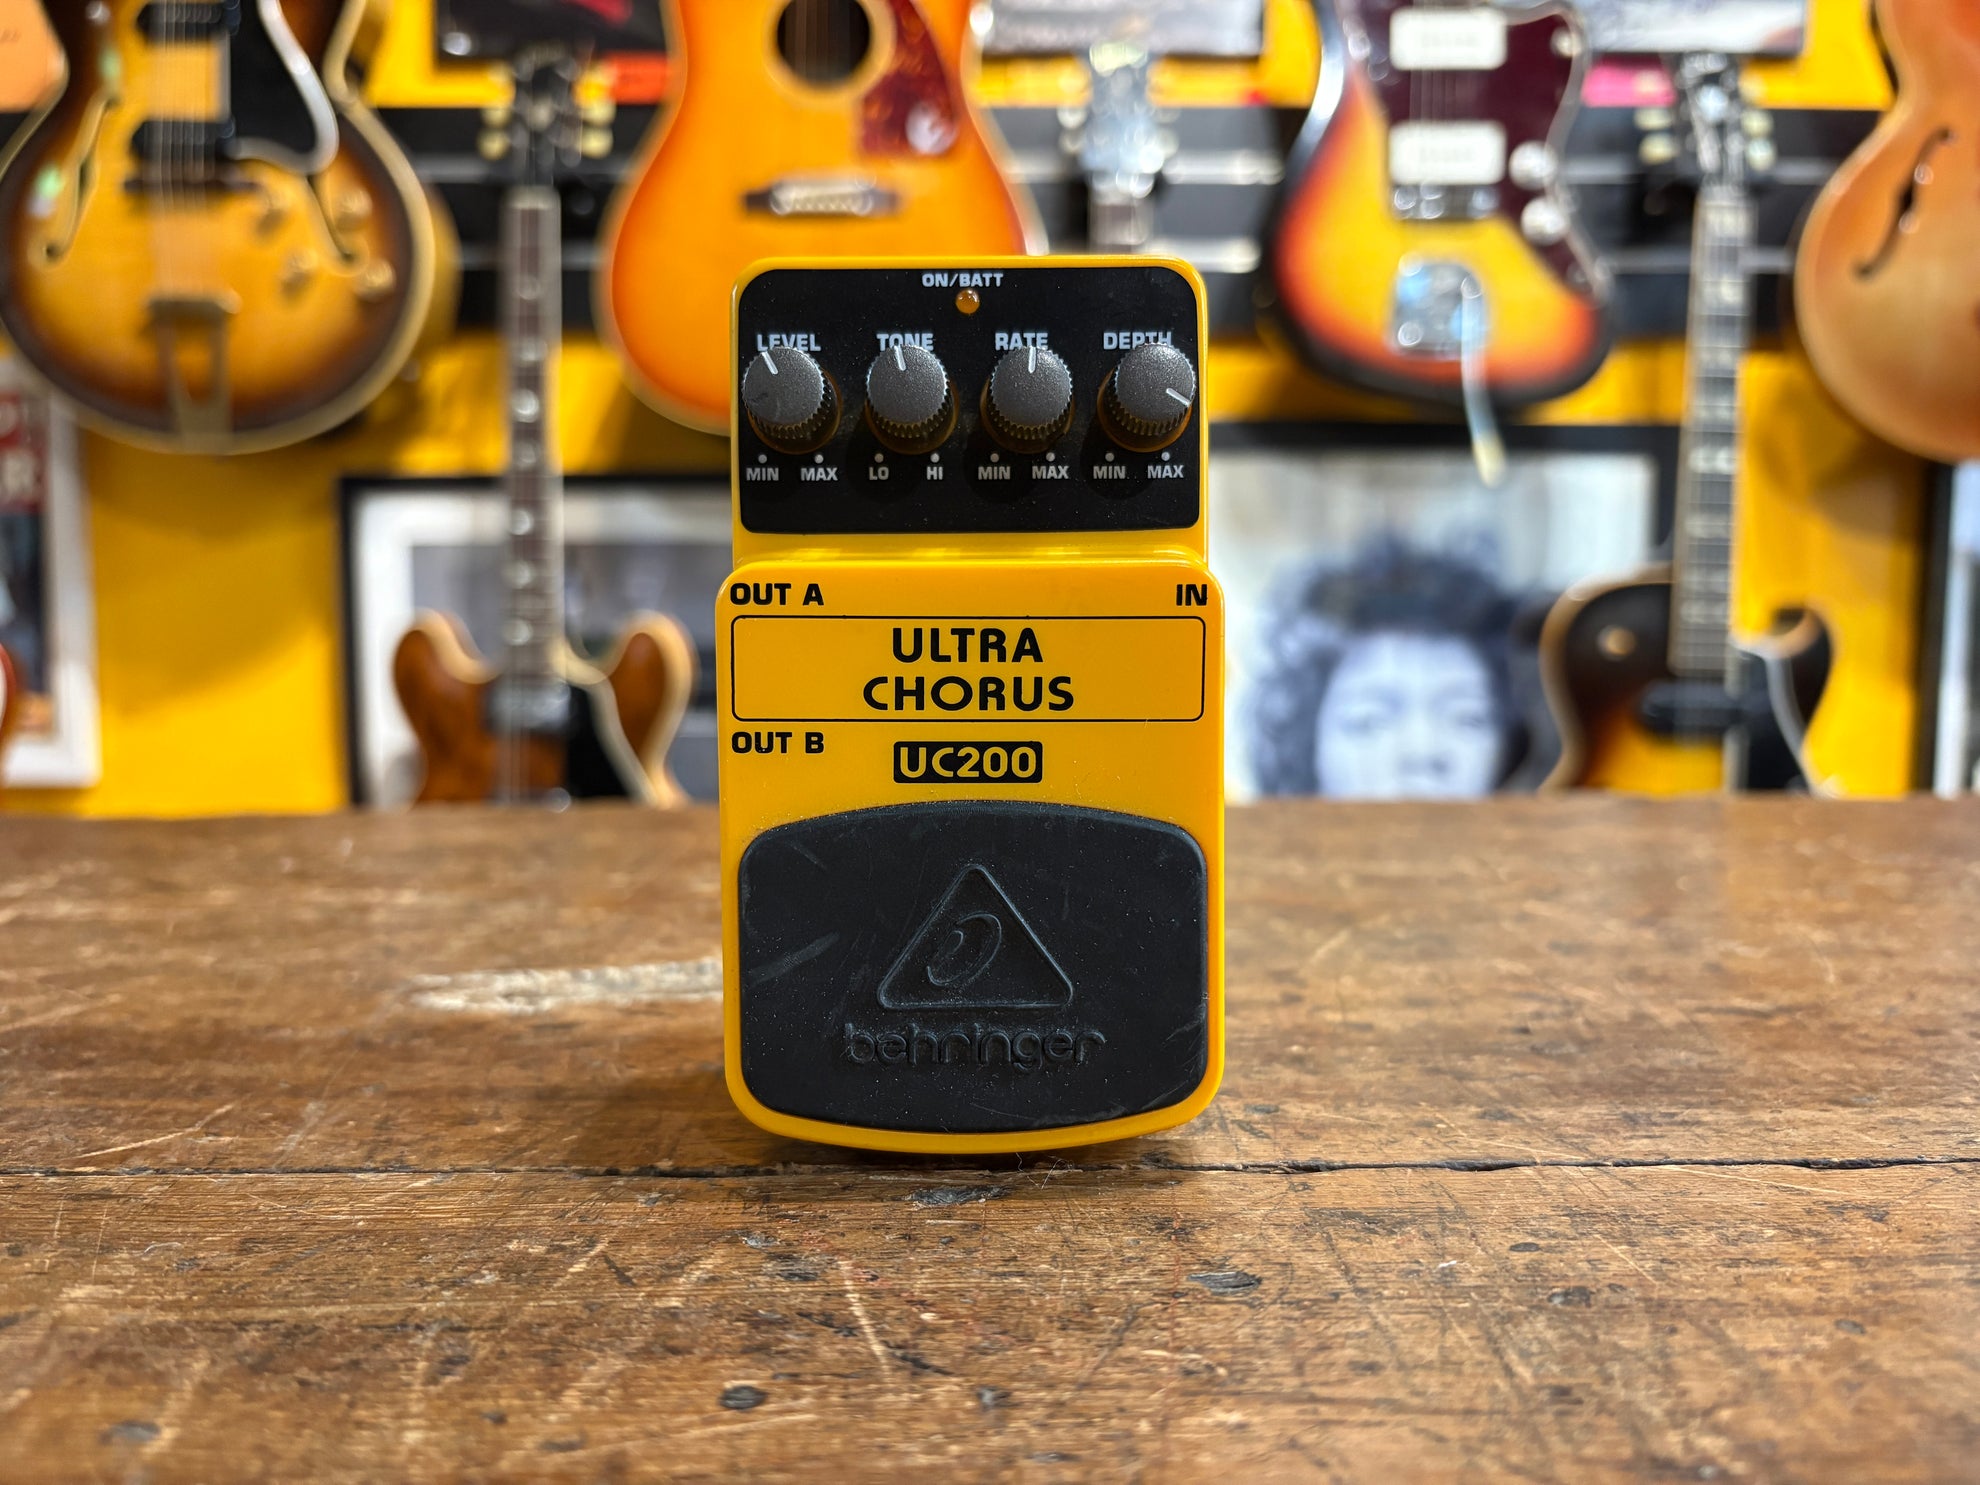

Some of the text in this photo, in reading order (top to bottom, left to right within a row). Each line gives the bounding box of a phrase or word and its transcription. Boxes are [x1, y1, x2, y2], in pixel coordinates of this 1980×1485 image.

[922, 272, 1004, 289] ON/BATT
[756, 333, 822, 353] LEVEL
[876, 333, 934, 352] TONE
[994, 332, 1048, 352] RATE
[1103, 332, 1172, 351] DEPTH
[746, 467, 779, 482] MIN
[800, 467, 838, 482] MAX
[869, 467, 889, 481] LO
[926, 467, 943, 481] HI
[978, 466, 1011, 481] MIN
[1031, 466, 1069, 480] MAX
[1093, 466, 1126, 480] MIN
[1147, 465, 1185, 479] MAX
[729, 582, 824, 606] OUT A
[1176, 584, 1208, 607] IN
[892, 627, 1043, 663] ULTRA
[863, 676, 1075, 712] CHORUS
[731, 731, 825, 755] OUT B
[899, 746, 1037, 780] UC200
[844, 1022, 1107, 1072] behringer
